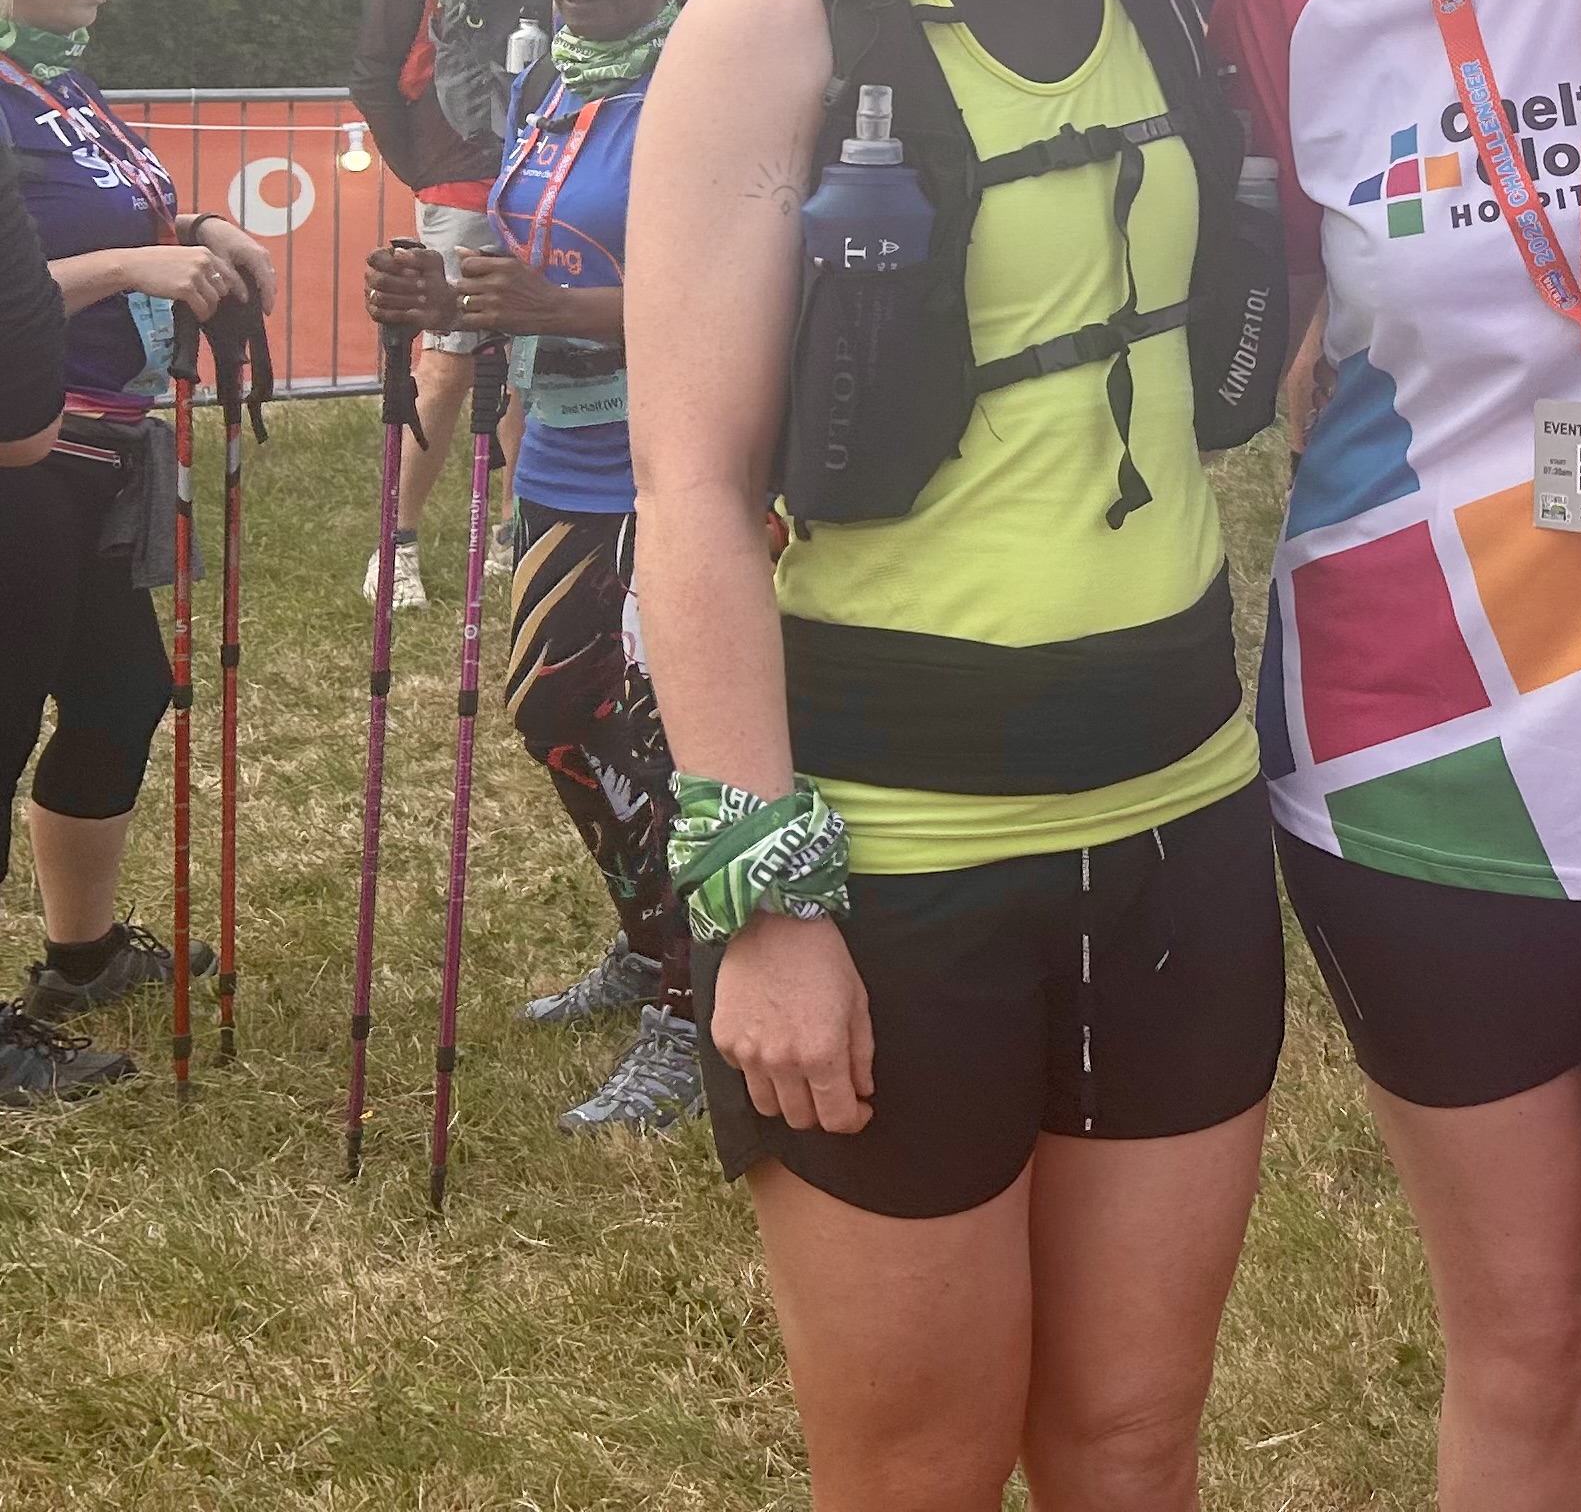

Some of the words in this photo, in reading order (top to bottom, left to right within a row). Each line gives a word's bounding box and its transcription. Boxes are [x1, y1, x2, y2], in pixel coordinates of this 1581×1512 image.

[1461, 58, 1529, 208] CHALLENGER
[1517, 209, 1557, 267] 2025
[1218, 287, 1270, 406] KINDER10L
[604, 396, 623, 411] (W)
